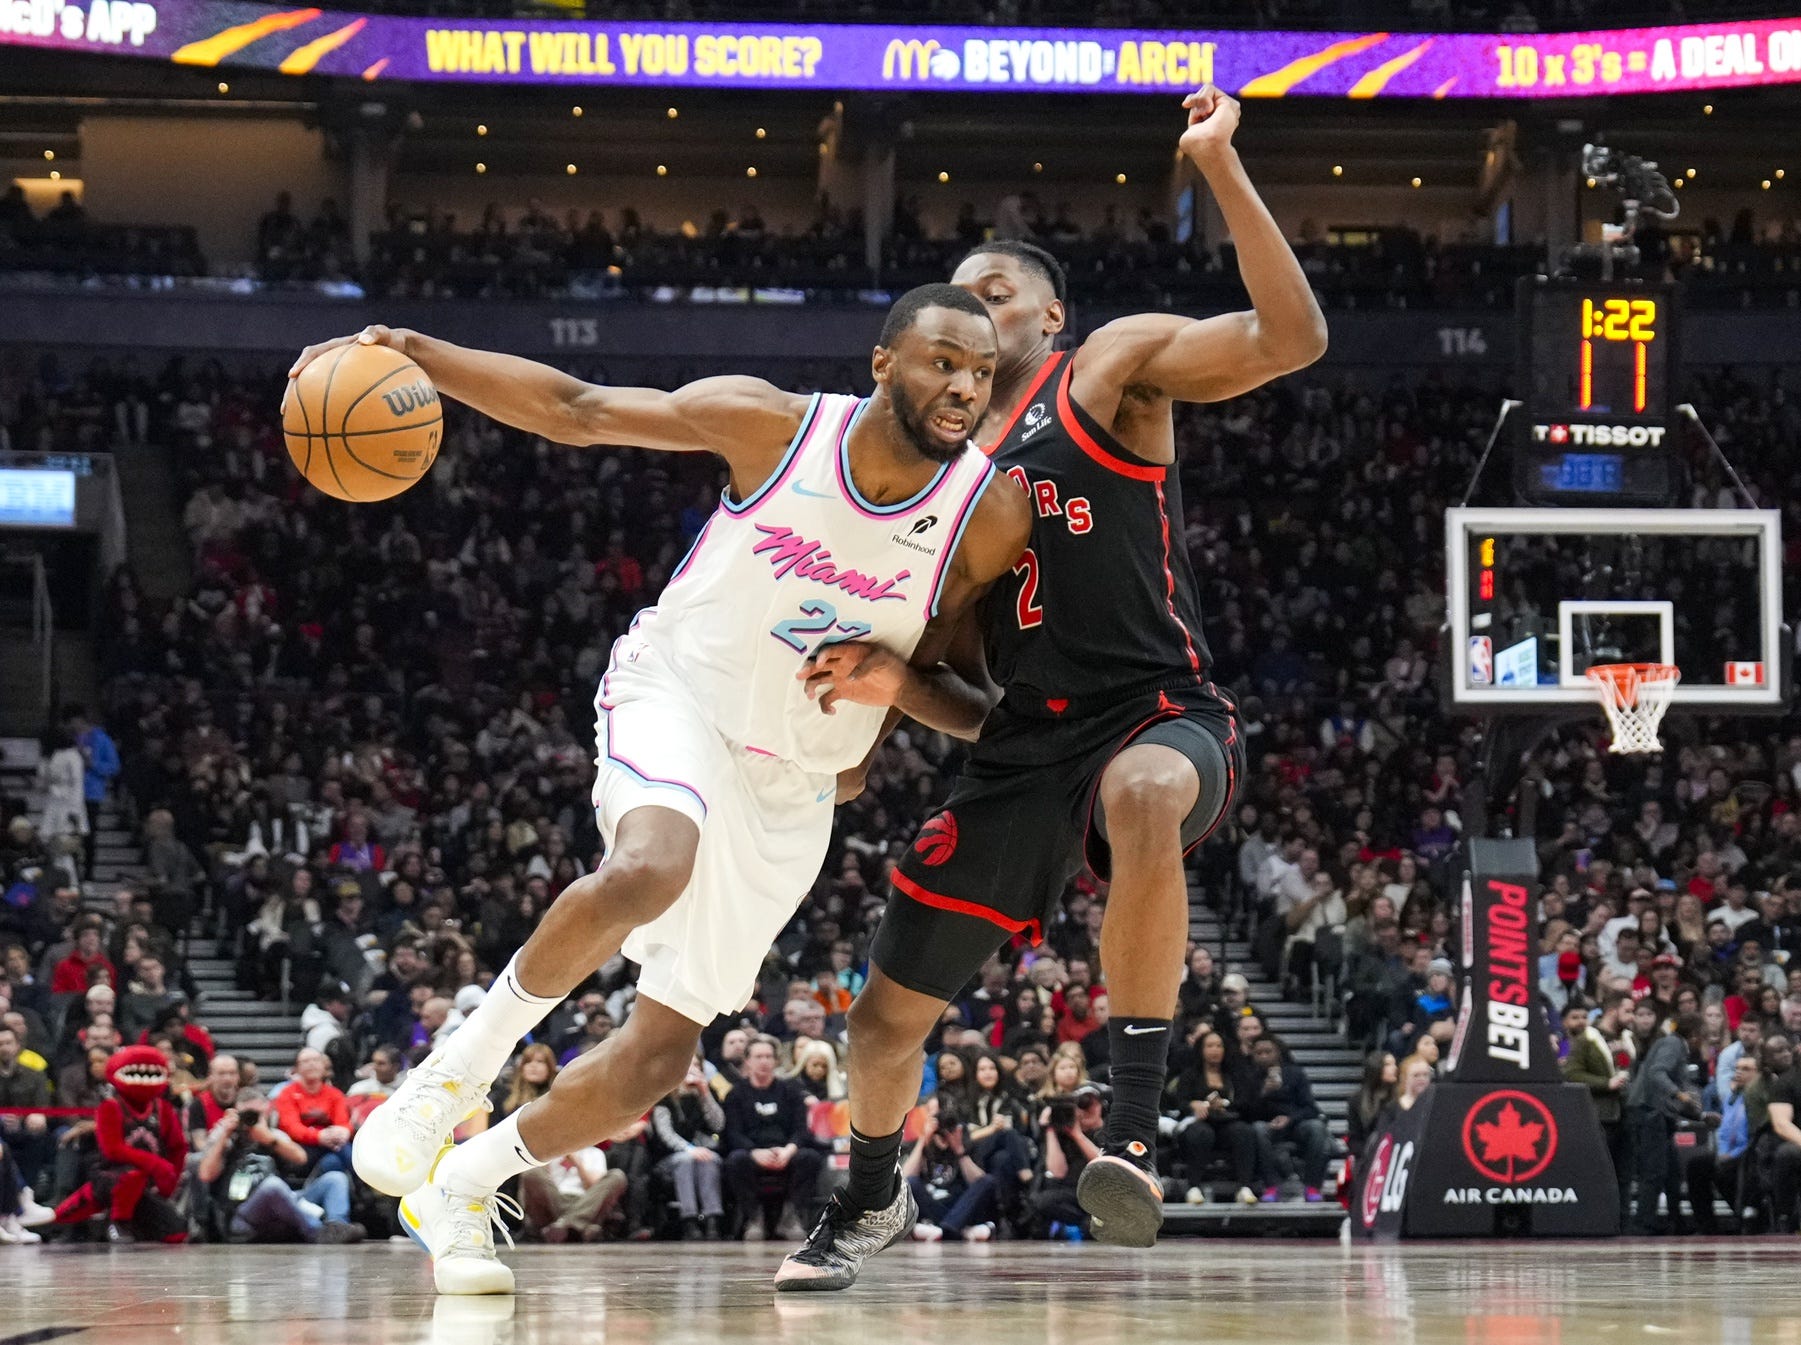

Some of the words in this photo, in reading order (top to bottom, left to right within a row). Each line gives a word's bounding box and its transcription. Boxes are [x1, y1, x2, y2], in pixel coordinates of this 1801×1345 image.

[87, 0, 157, 46] APP
[426, 30, 526, 73] WHAT
[529, 32, 616, 75] WILL
[619, 33, 689, 76] YOU
[694, 35, 822, 78] SCORE?
[964, 39, 1102, 84] BEYOND
[1116, 40, 1214, 85] ARCH
[1496, 45, 1538, 87] 10
[1544, 54, 1566, 86] x
[1571, 43, 1622, 84] 3's
[1651, 38, 1676, 82] A
[1680, 33, 1763, 78] DEAL
[549, 318, 598, 346] 113
[1582, 299, 1656, 341] 1:22
[1021, 427, 1036, 442] Sun
[1036, 416, 1052, 431] Life
[1569, 425, 1666, 446] TISSOT
[752, 523, 911, 601] Miami
[892, 534, 936, 556] Robinhood
[1487, 879, 1530, 1069] POINTSBET
[1444, 1187, 1482, 1204] AIR
[1485, 1187, 1579, 1204] CANADA
